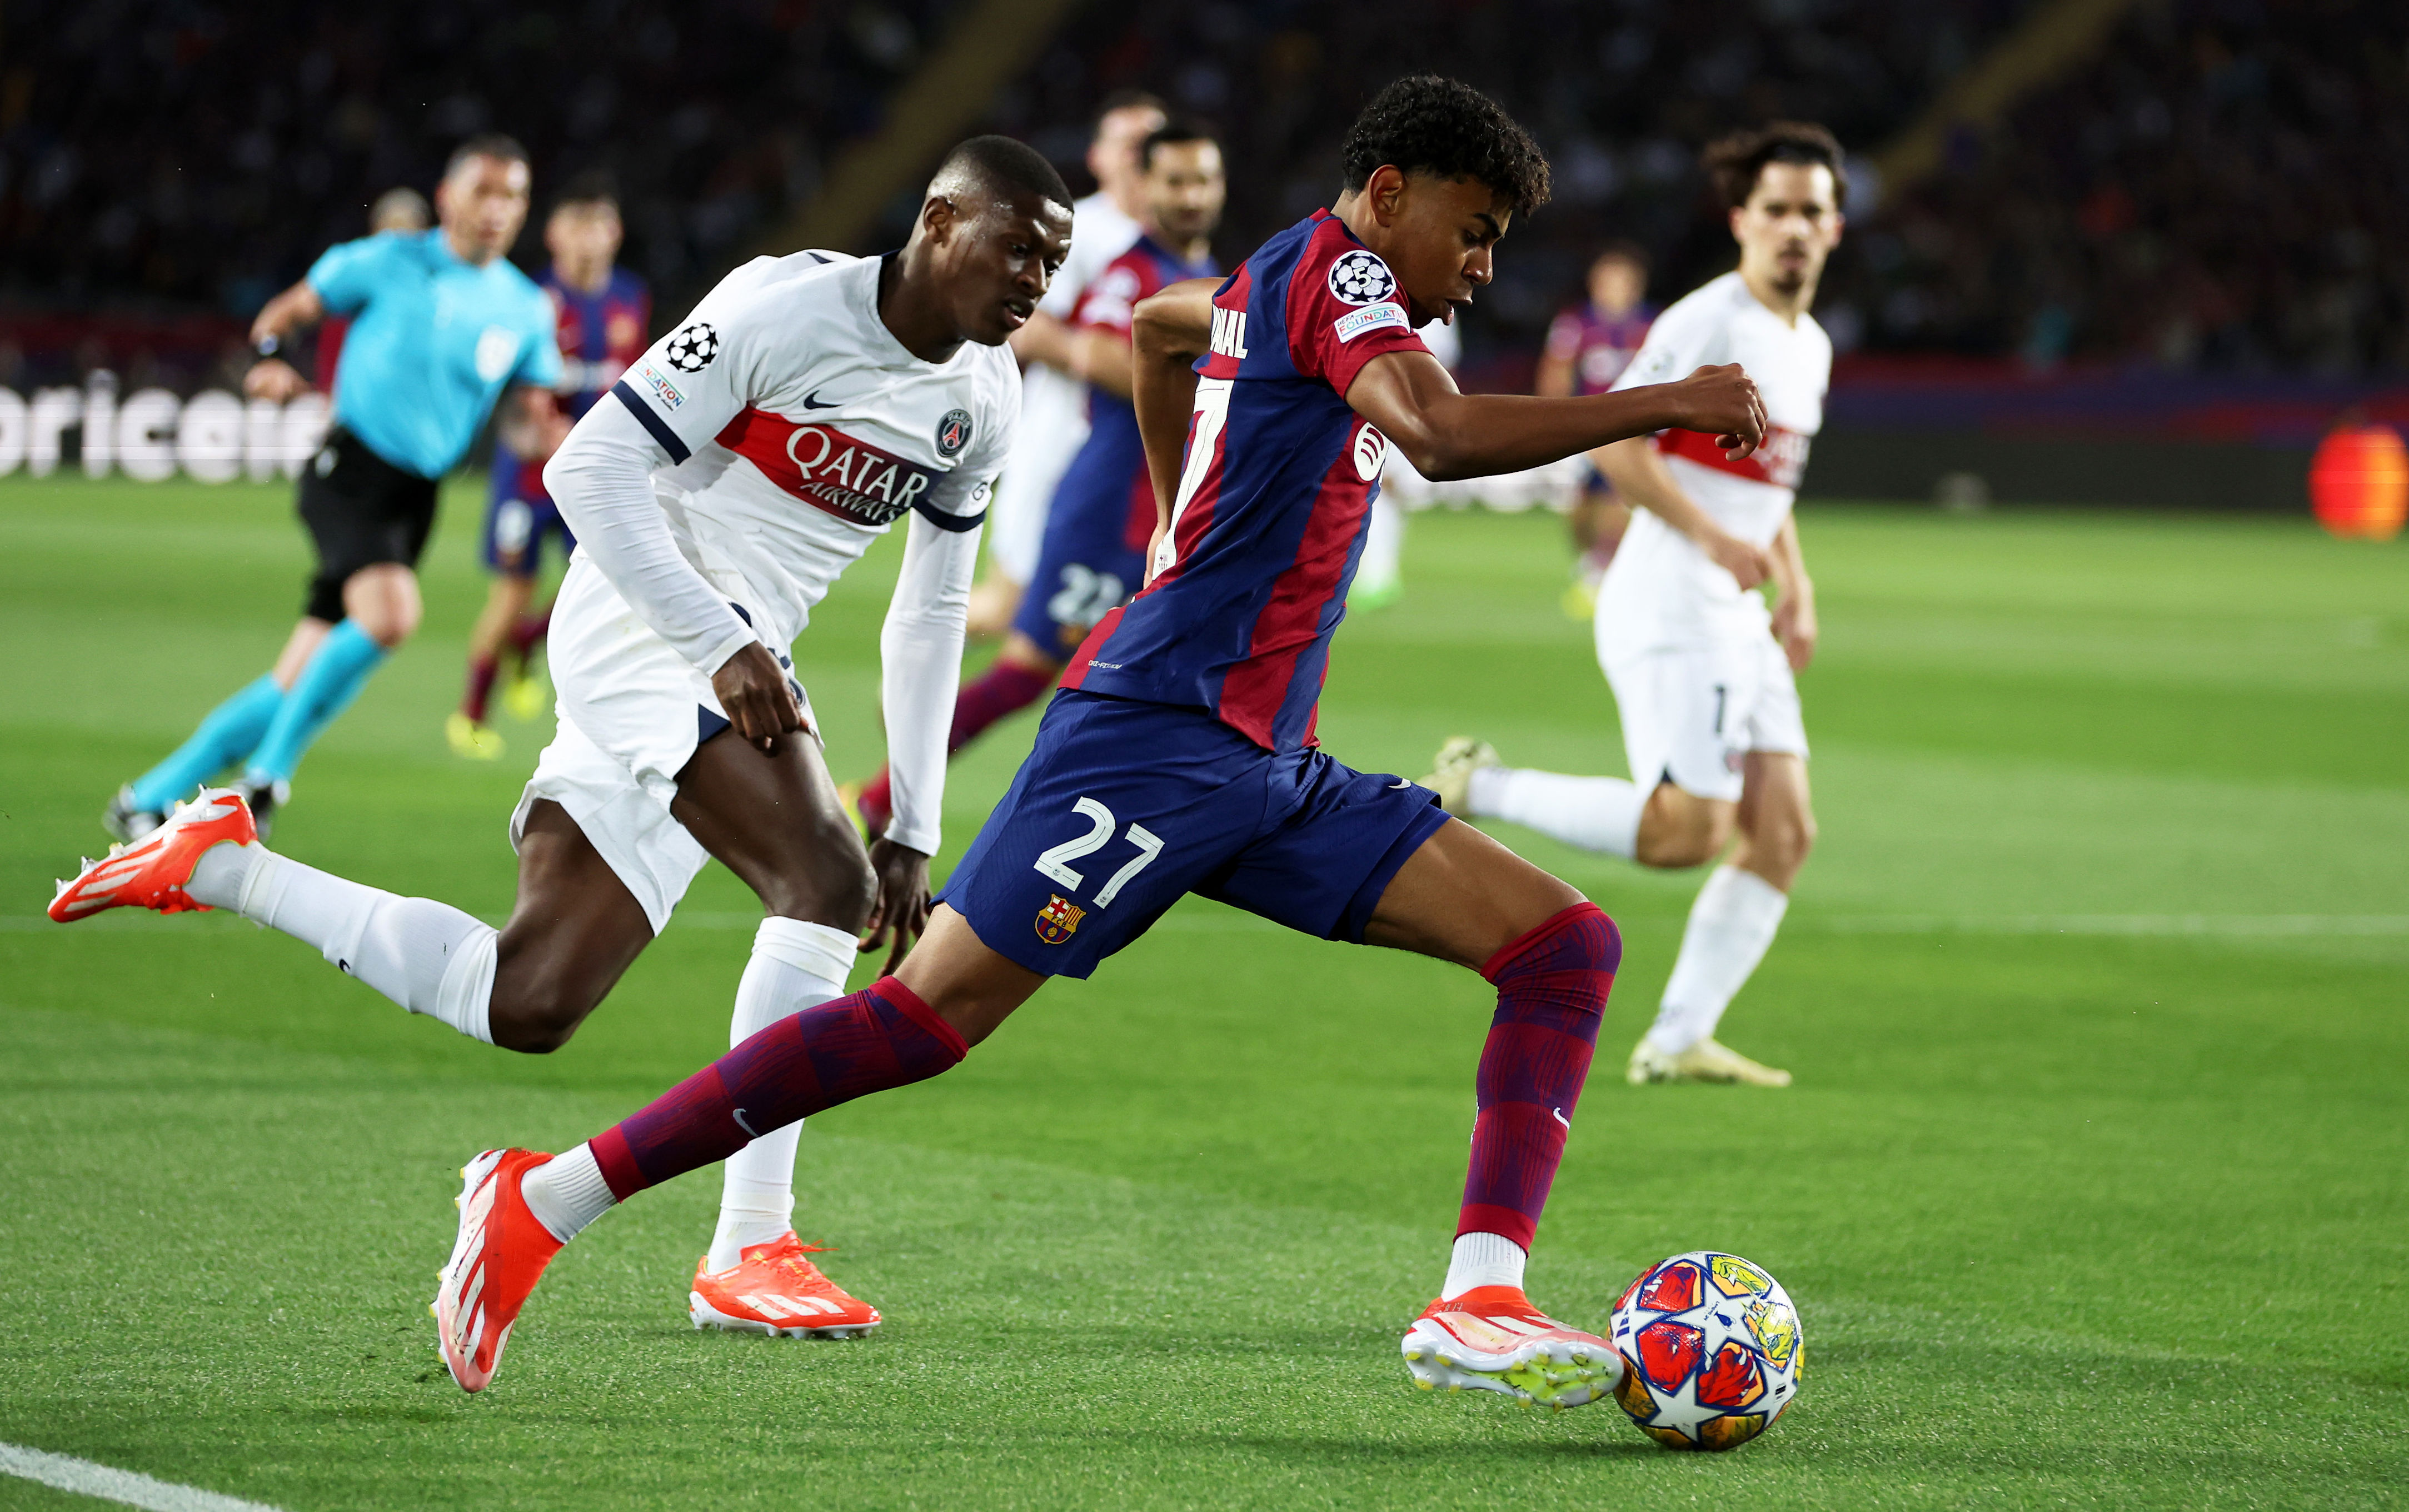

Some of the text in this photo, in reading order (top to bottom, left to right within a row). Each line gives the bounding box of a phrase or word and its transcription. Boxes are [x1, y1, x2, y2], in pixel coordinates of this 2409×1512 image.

[1353, 266, 1373, 288] 5
[1210, 304, 1249, 360] AMAL
[1337, 315, 1355, 327] UEFA
[1339, 310, 1408, 335] FOUNDATIO
[947, 413, 971, 429] PARIS
[786, 426, 929, 508] QATAR
[799, 481, 903, 524] AIRWAYS
[1033, 796, 1166, 910] 27
[1051, 915, 1067, 927] FCB
